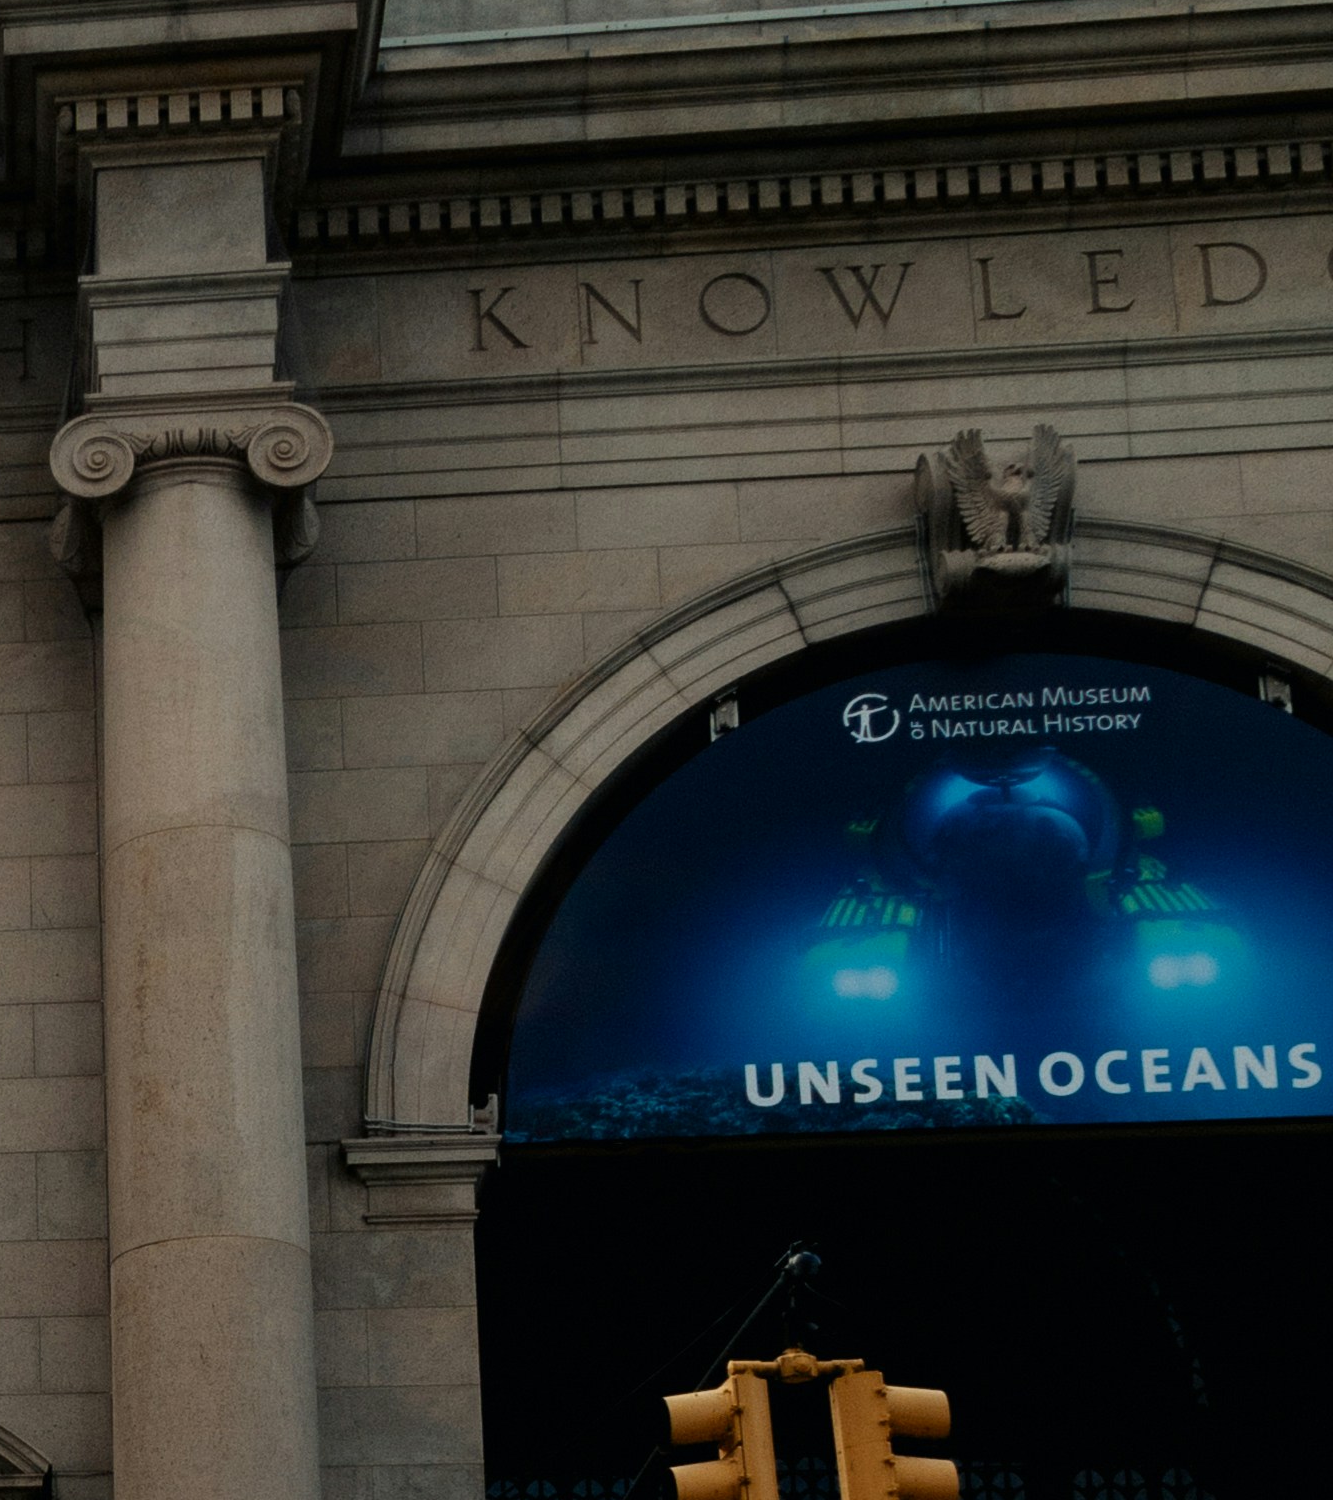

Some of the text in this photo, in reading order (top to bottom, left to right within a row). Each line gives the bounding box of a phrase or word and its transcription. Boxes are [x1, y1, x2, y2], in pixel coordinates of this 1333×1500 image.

[466, 240, 1333, 353] KNOWLED
[908, 686, 1151, 713] AMERICAN MUSEUM
[910, 713, 1142, 740] OF NATURAL HISTORY
[744, 1042, 1323, 1107] UNSEEN OCEANS
